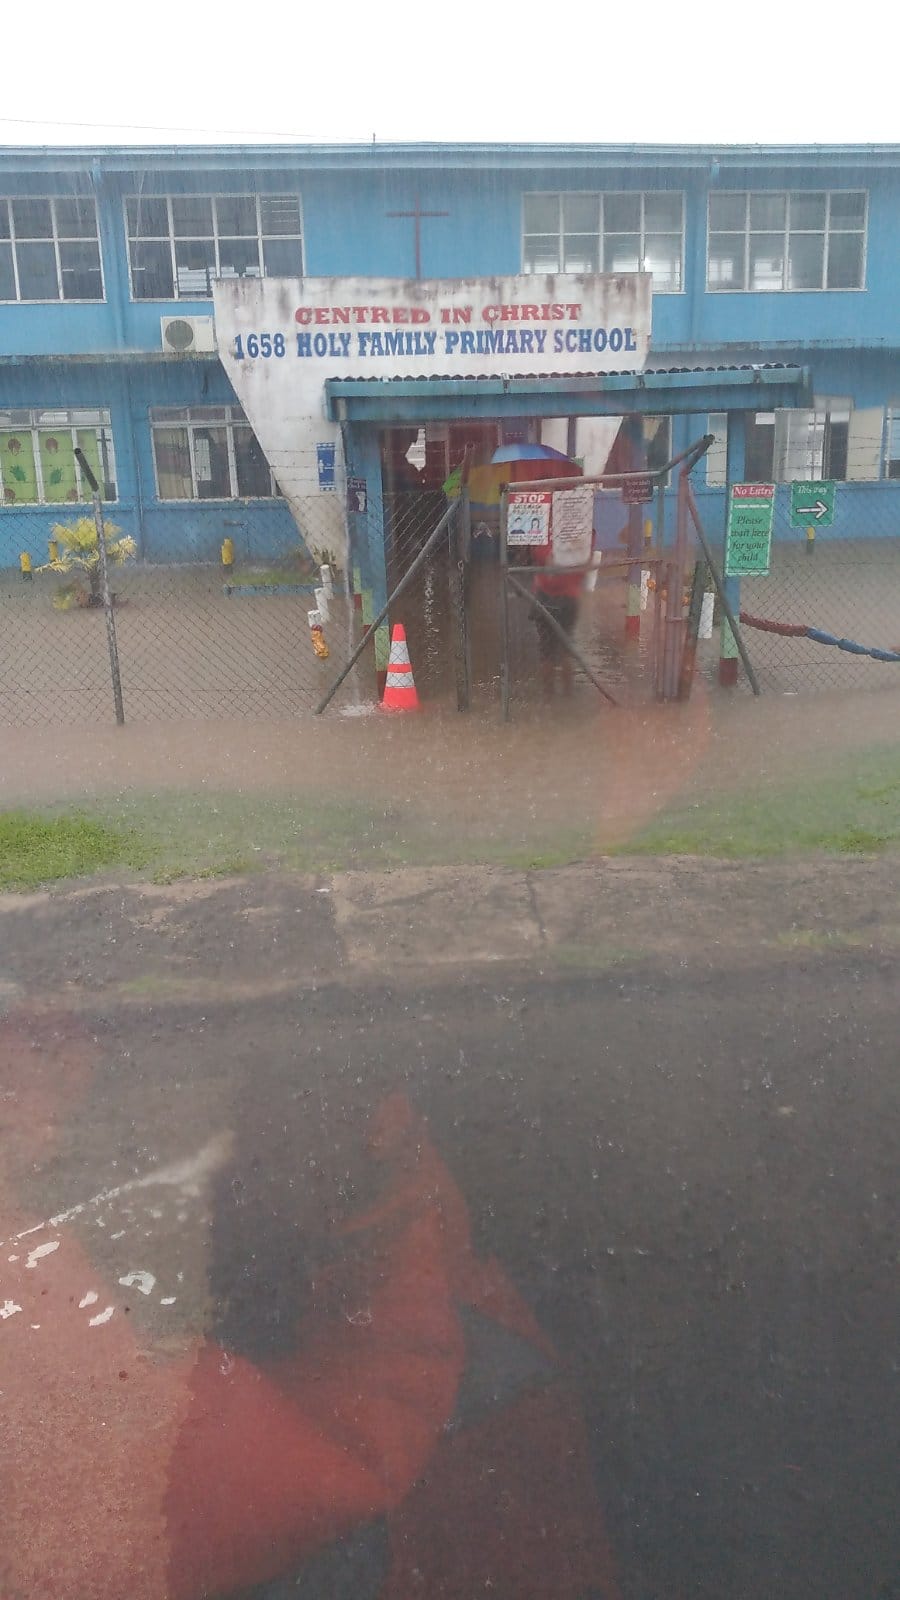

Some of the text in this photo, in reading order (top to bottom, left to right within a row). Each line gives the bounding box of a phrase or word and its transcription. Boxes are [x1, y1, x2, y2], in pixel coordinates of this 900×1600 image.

[295, 303, 582, 325] CENTRED IN CHRIST
[234, 327, 637, 360] 1658 HOLY FAMILY PRIMARY SCHOOL
[734, 486, 748, 495] No
[514, 494, 545, 503] STOP
[737, 515, 763, 525] Please
